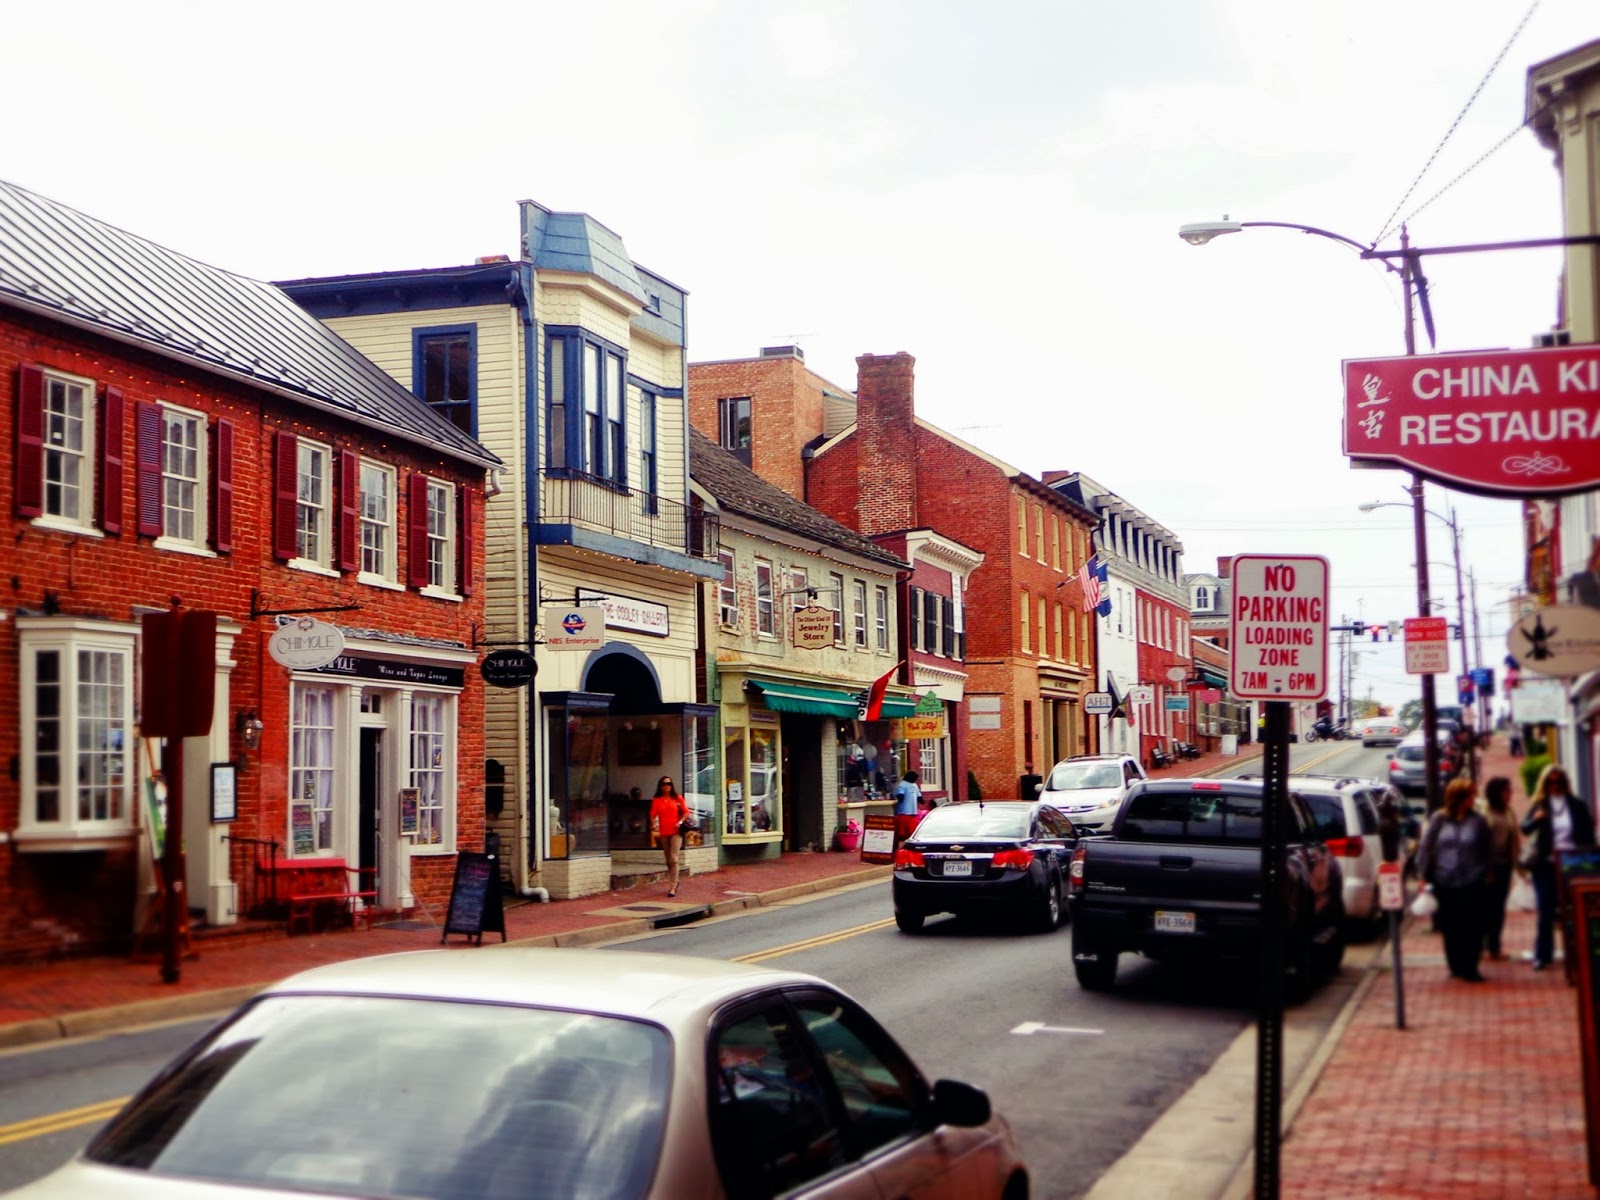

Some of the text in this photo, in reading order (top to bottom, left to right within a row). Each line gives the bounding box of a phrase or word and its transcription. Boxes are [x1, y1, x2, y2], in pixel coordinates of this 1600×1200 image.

[1412, 364, 1539, 400] CHINA
[1264, 566, 1296, 592] NO
[1238, 596, 1321, 623] PARKING
[798, 624, 829, 633] Jewelry
[803, 633, 825, 641] Store
[1246, 627, 1313, 646] LOADING
[566, 637, 599, 645] Enterprise
[1259, 649, 1299, 666] ZONE
[1242, 672, 1268, 689] 7AM
[1289, 672, 1316, 690] 6PM
